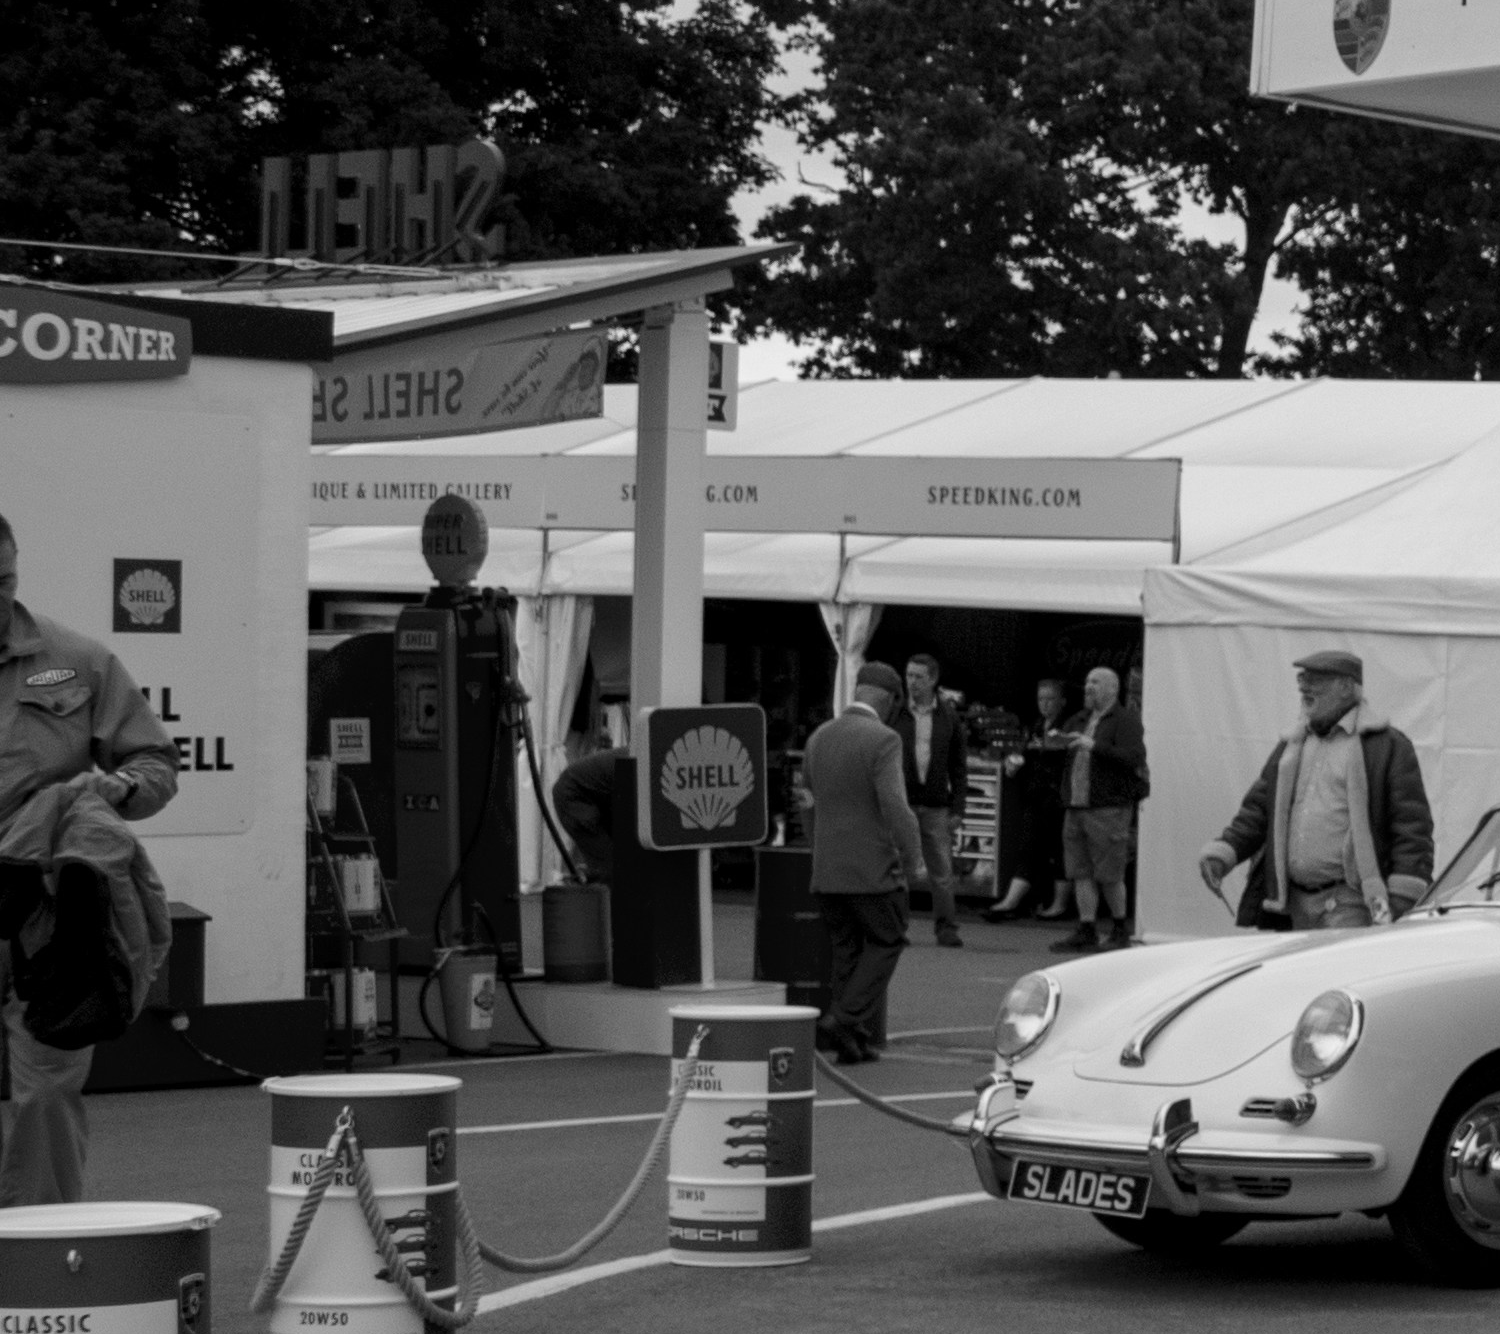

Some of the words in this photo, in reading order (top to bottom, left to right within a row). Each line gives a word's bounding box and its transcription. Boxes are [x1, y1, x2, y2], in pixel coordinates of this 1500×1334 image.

[312, 482, 349, 501] IQUE
[374, 482, 438, 500] LIMITED
[926, 485, 1083, 510] SPEEDKING.COM
[128, 587, 167, 603] SHELL
[676, 763, 741, 789] SHELL
[1022, 1164, 1136, 1211] SLADES
[2, 1314, 92, 1334] CLASSIC
[300, 1311, 349, 1326] 20W50
